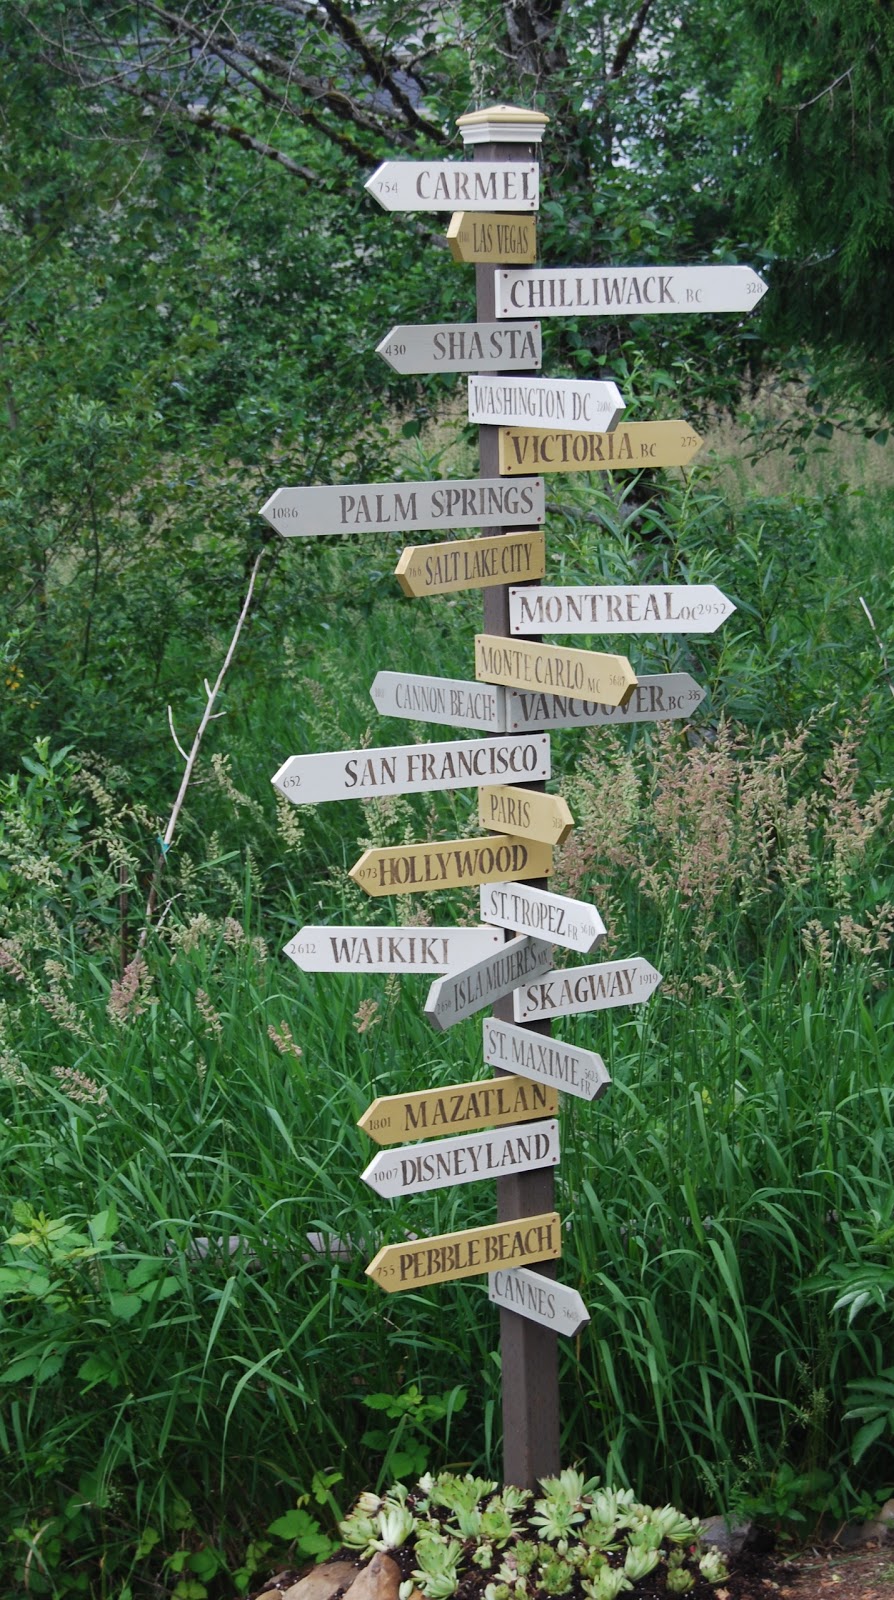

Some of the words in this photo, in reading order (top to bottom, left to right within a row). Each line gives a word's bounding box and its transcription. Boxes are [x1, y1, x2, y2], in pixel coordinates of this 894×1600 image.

[378, 181, 398, 193] 754
[416, 171, 537, 200] CARMEL
[472, 223, 493, 253] LAS
[496, 224, 529, 254] VEGAS
[686, 288, 702, 304] BC
[746, 282, 763, 294] 328
[385, 344, 406, 356] 430
[433, 330, 538, 360] SHASTA
[474, 385, 566, 419] WASHINGTON
[572, 392, 591, 421] DC
[641, 443, 657, 458] BC
[681, 437, 698, 448] 275
[272, 507, 299, 519] 1086
[339, 492, 418, 524] PALM
[431, 486, 534, 518] SPRINGS
[425, 551, 461, 585] SALT
[464, 547, 499, 581] LAKE
[502, 543, 533, 574] CITY
[519, 592, 681, 624] MONTREAL
[699, 603, 727, 615] 2952
[481, 645, 532, 681] MONTE
[535, 656, 585, 690] CARLO
[587, 677, 601, 694] MC
[395, 683, 446, 714] CANNON
[450, 690, 493, 721] BEACH
[668, 695, 685, 711] BC
[688, 690, 701, 701] 335
[283, 775, 301, 788] 652
[344, 756, 397, 788] SAN
[406, 744, 538, 783] FRANCISCO
[489, 793, 532, 829] PARIS
[359, 867, 378, 880] 973
[378, 844, 529, 887] HOLLYWOOD
[510, 893, 566, 936] TROPEZ
[567, 924, 579, 941] FR
[290, 943, 316, 954] 2612
[329, 936, 450, 965] WAIKIKI
[454, 970, 484, 1012] ISLA
[486, 943, 537, 994] MUJERES
[526, 967, 638, 1013] SKAGWAY
[638, 972, 659, 987] 1919
[488, 1029, 508, 1060] ST.
[512, 1036, 580, 1087] MAXIME
[580, 1077, 592, 1096] FR
[369, 1116, 392, 1131] 1801
[404, 1083, 548, 1131] MAZATLAN
[374, 1168, 398, 1183] 1007
[400, 1133, 550, 1187] DISNEYLAND
[377, 1266, 396, 1278] 755
[400, 1239, 481, 1282] PEBBLE
[484, 1223, 553, 1263] BEACH
[494, 1271, 556, 1320] CANNES
